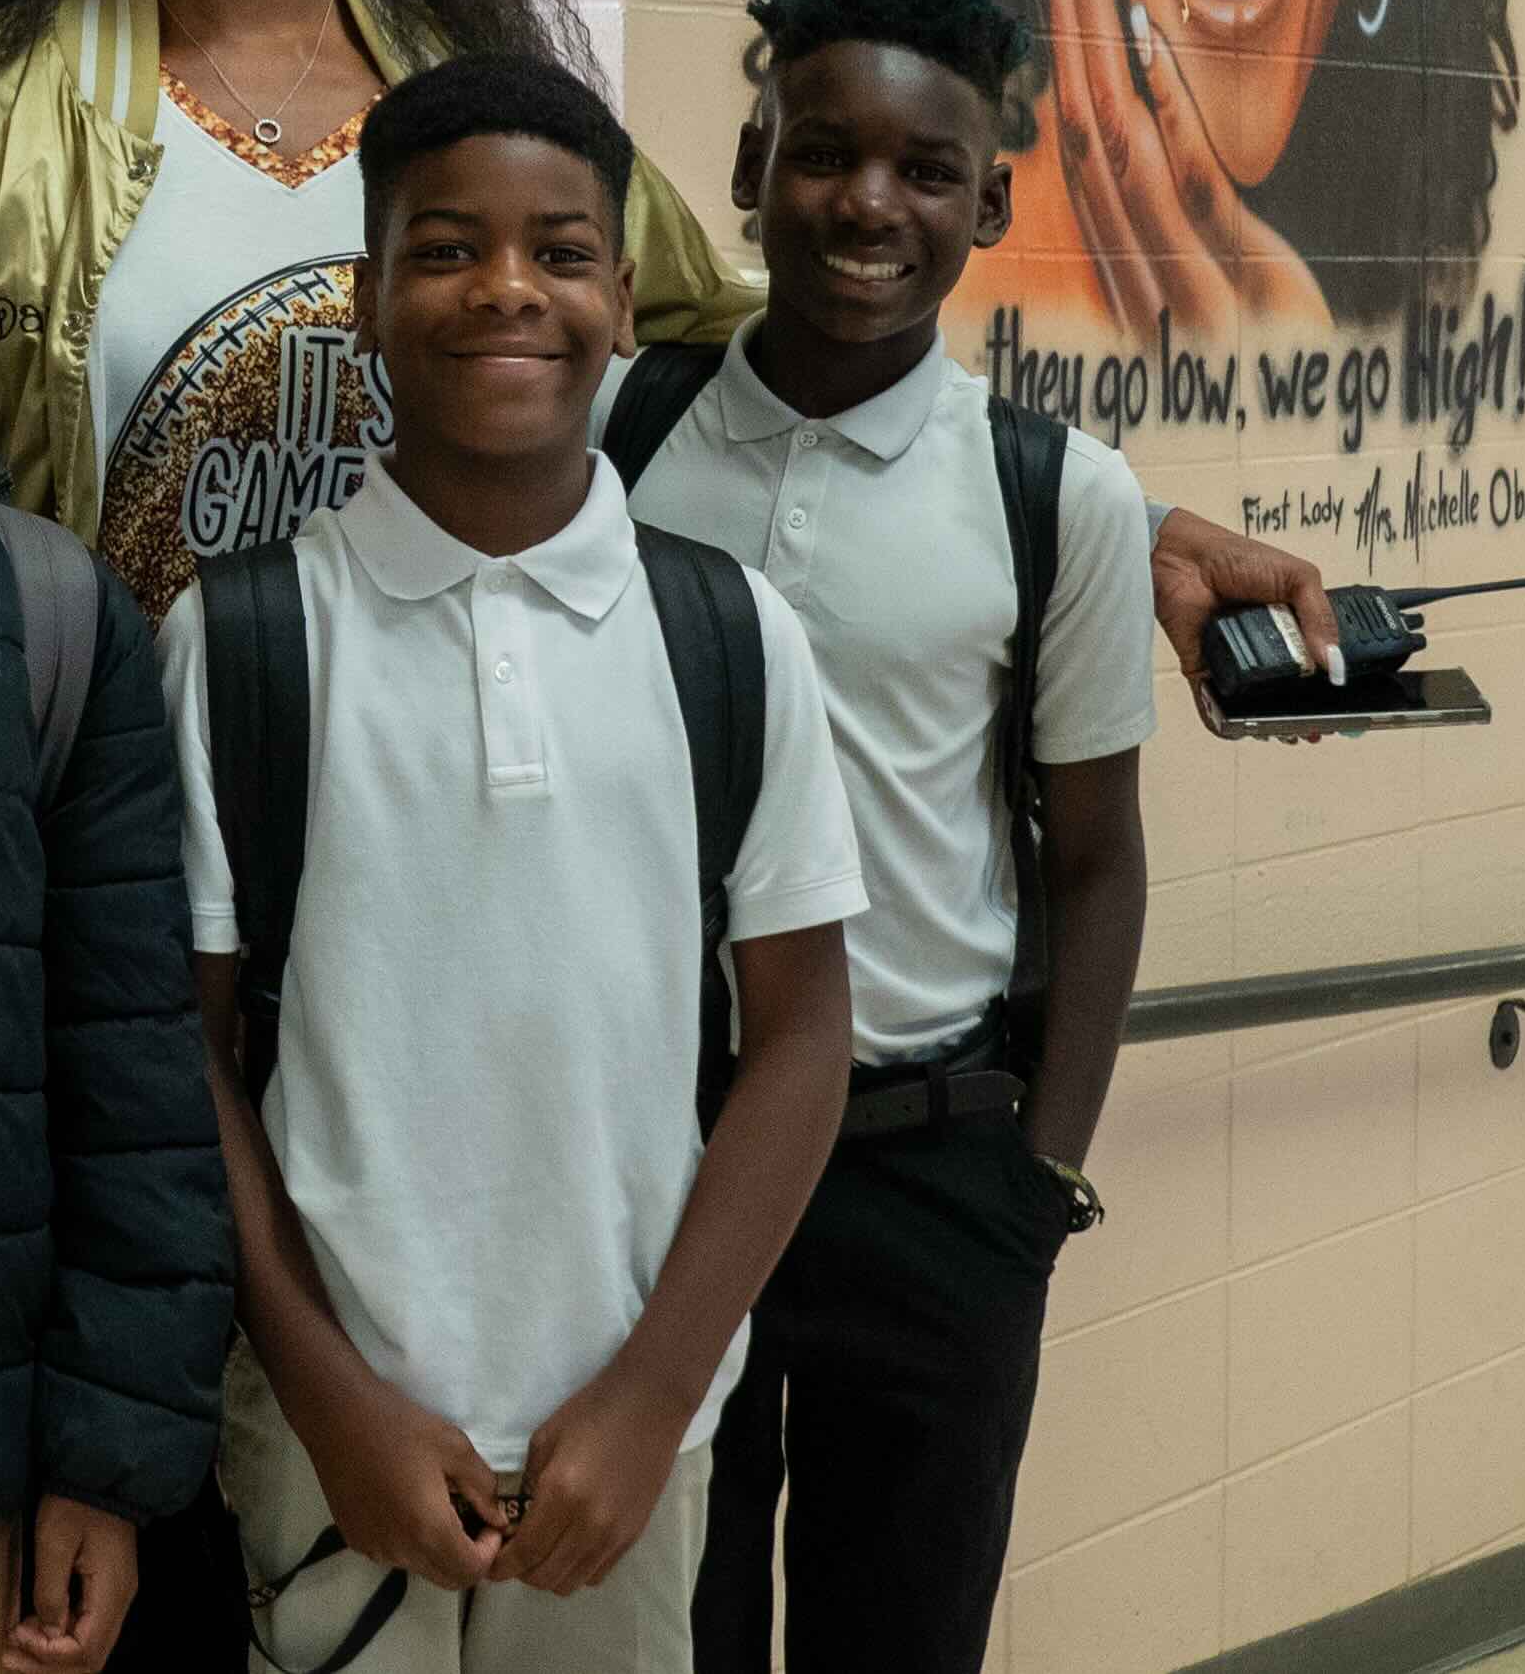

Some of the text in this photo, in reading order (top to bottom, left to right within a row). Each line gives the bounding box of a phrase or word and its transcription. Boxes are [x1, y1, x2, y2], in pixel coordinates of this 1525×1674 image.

[985, 304, 1084, 430] they
[1094, 354, 1148, 449] go
[1157, 306, 1245, 430] low,
[1259, 348, 1325, 419] we
[1337, 342, 1391, 453] go
[1241, 489, 1291, 538] First
[1301, 485, 1344, 535] Lady
[1403, 450, 1479, 564] Michelle
